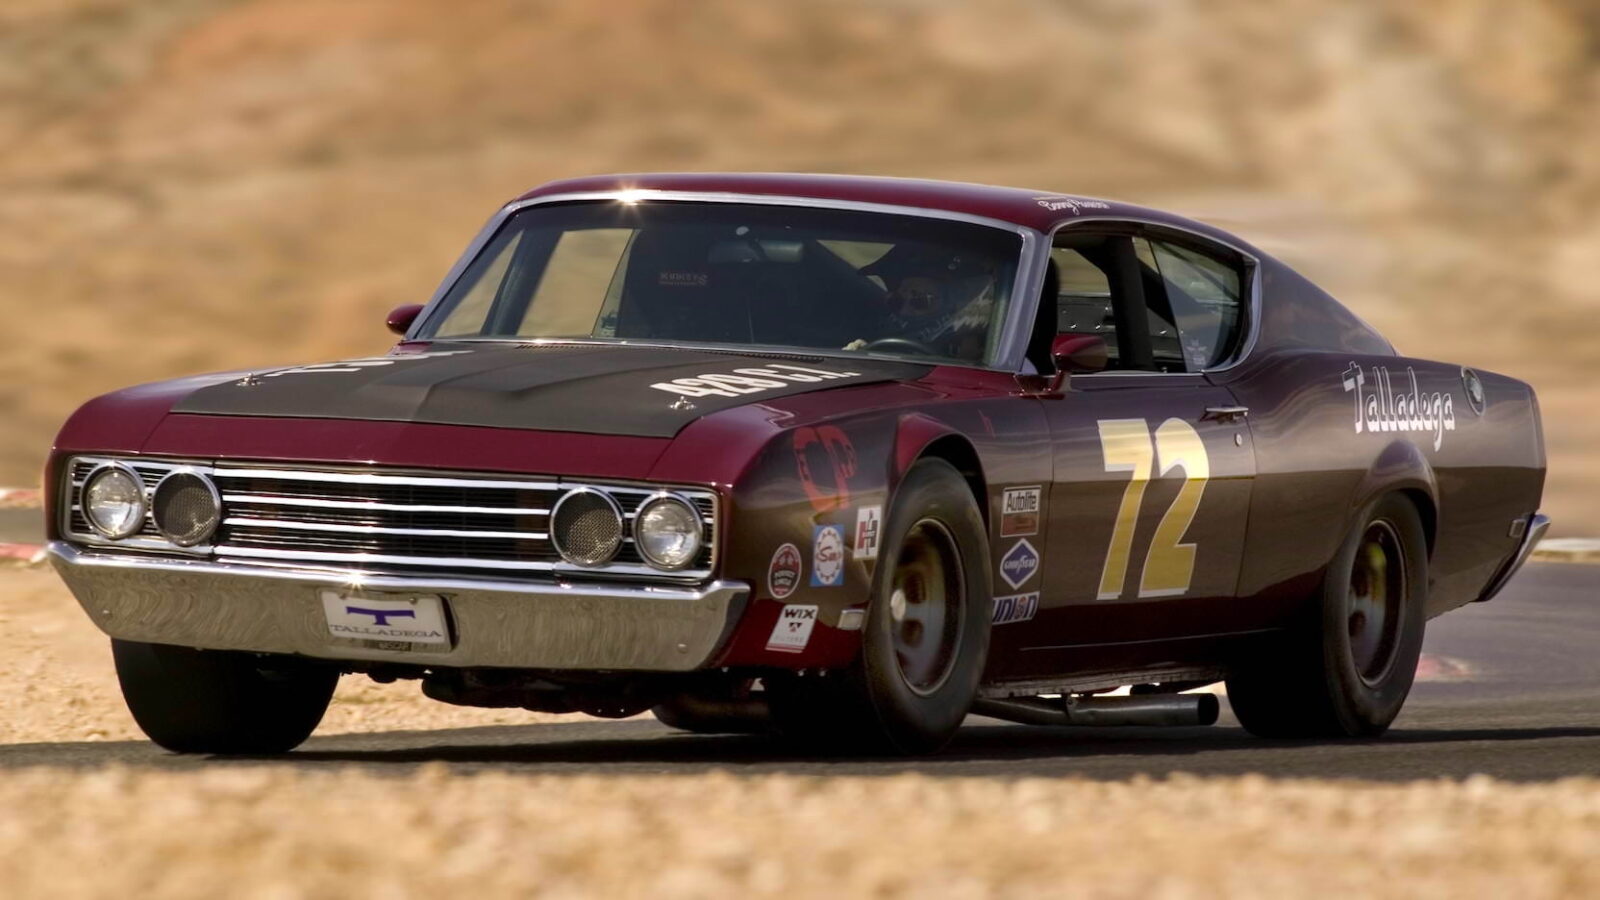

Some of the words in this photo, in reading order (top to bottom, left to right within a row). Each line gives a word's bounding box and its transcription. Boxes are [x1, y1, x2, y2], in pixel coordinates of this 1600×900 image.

[1341, 360, 1456, 452] Talladega
[1005, 491, 1037, 512] Autolite
[1096, 416, 1210, 601] 72
[783, 608, 816, 620] WIX
[330, 624, 442, 638] TALLADEGA
